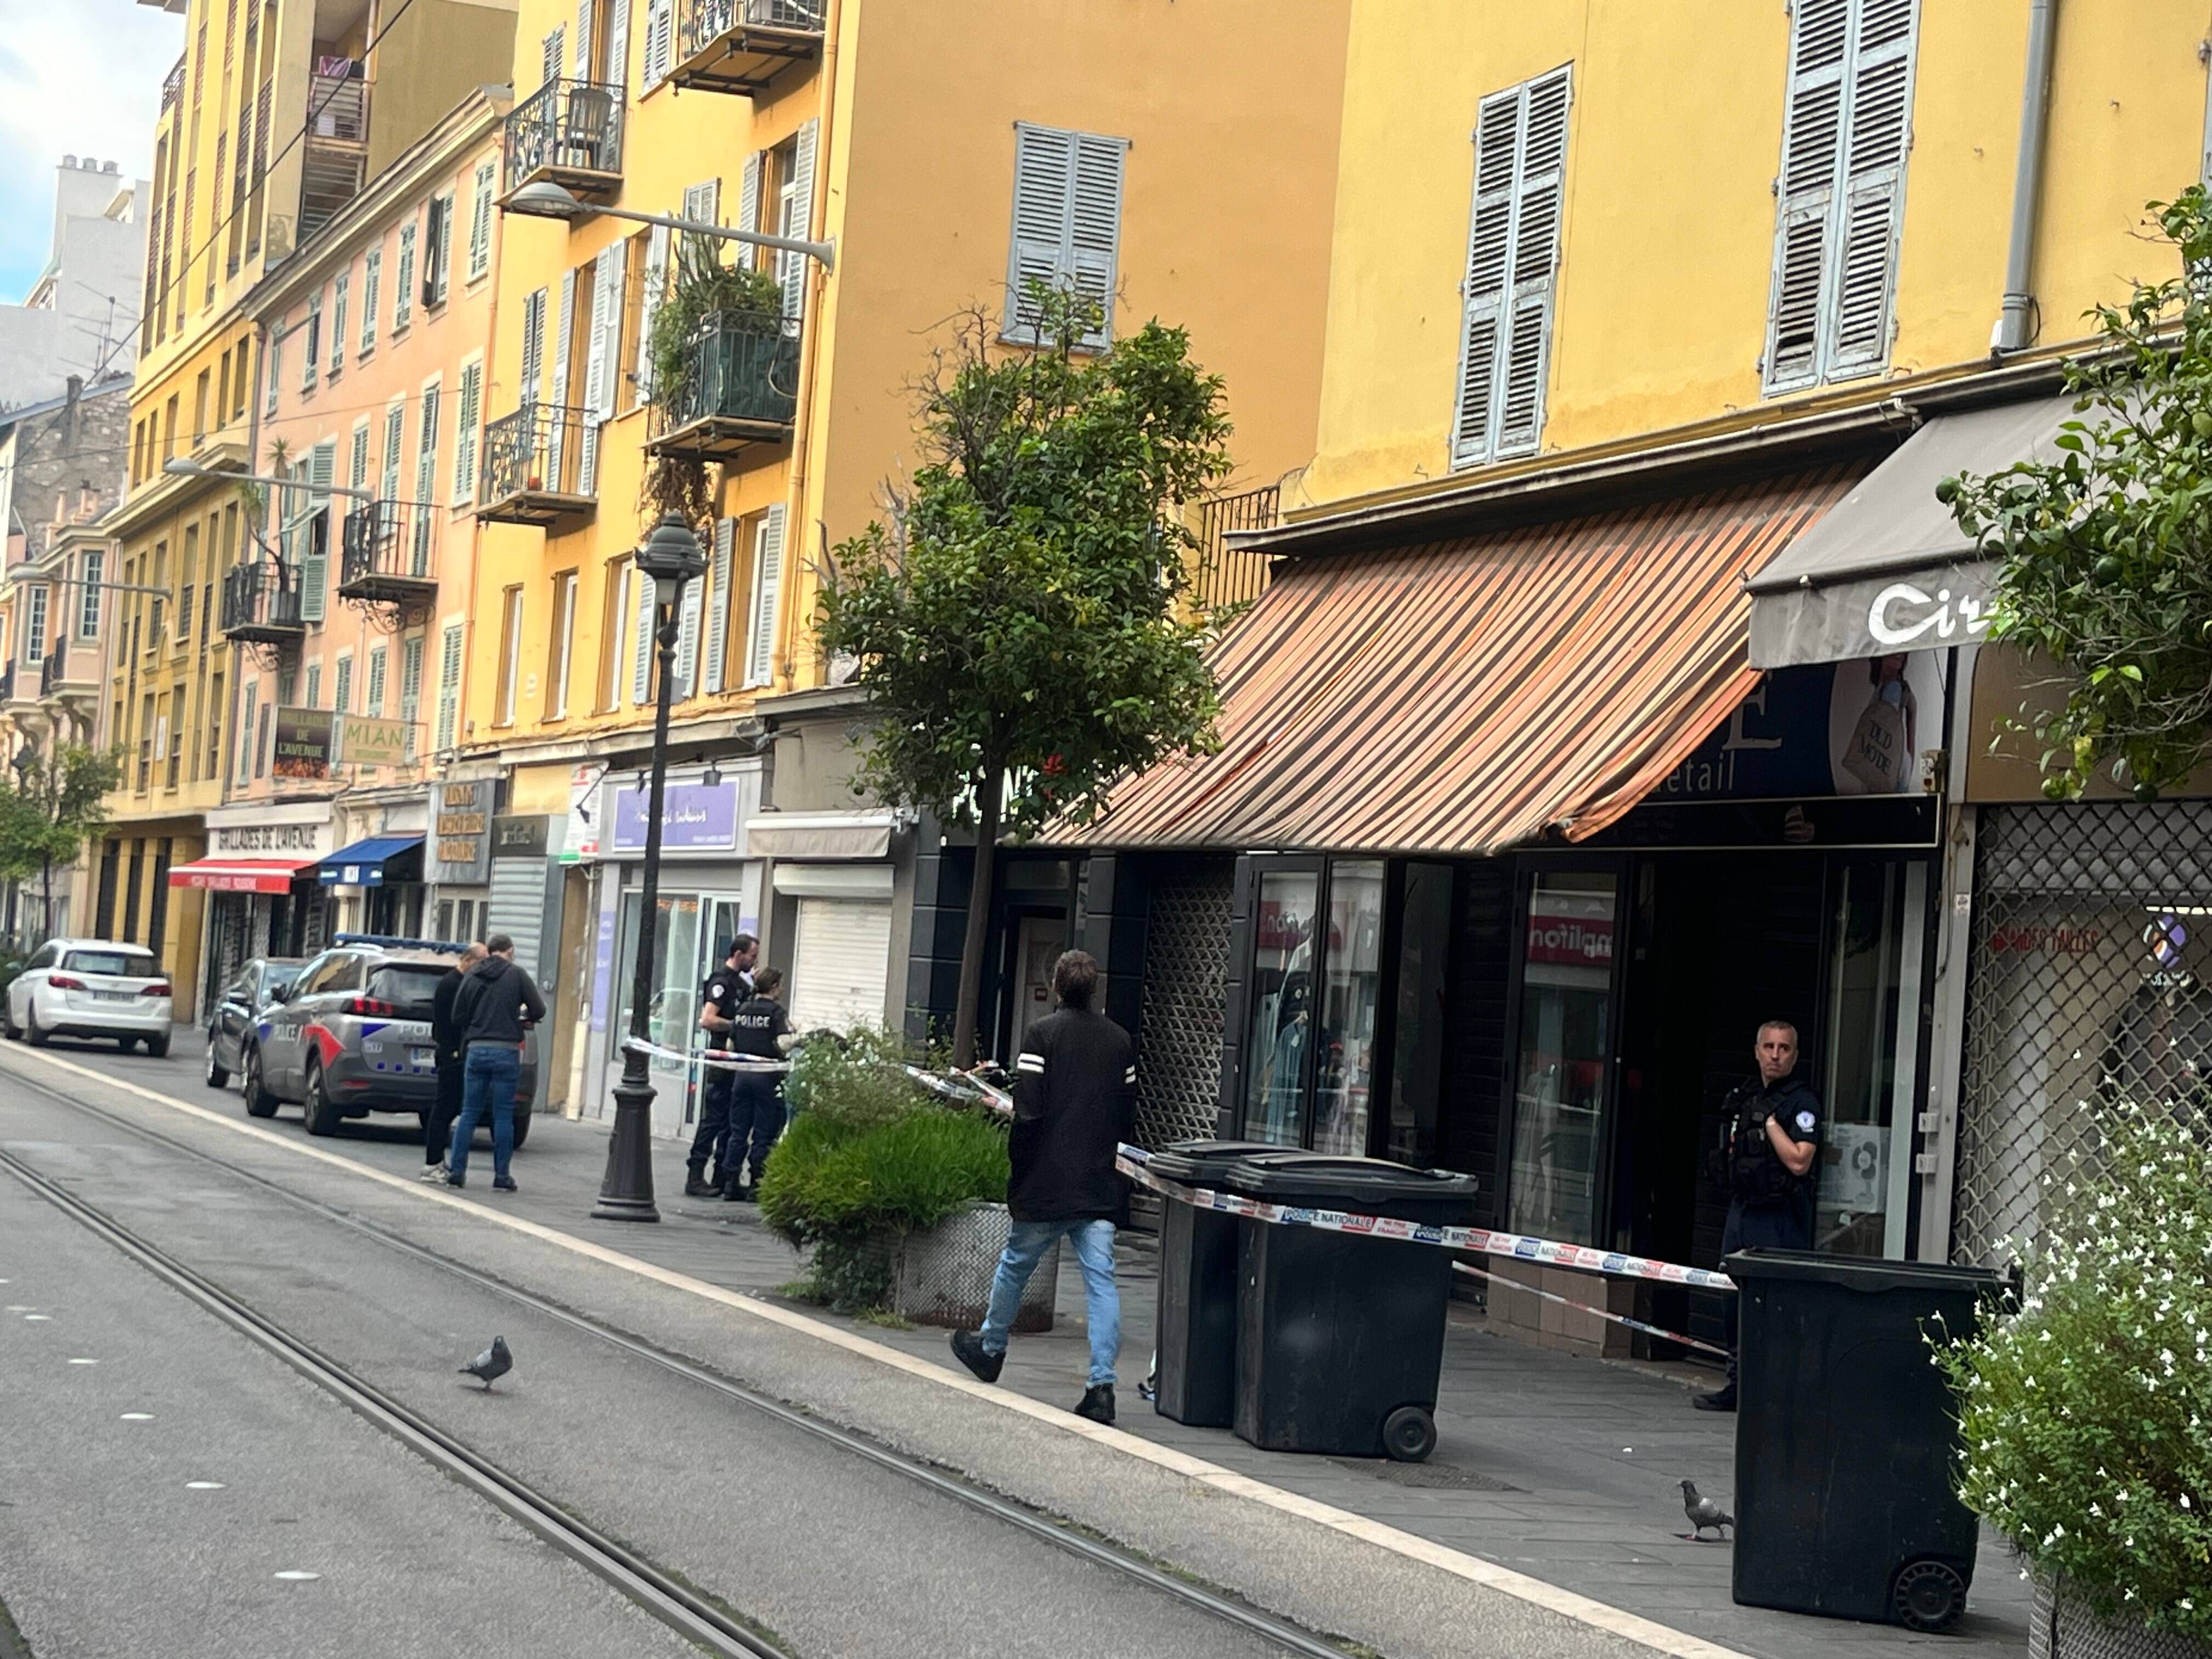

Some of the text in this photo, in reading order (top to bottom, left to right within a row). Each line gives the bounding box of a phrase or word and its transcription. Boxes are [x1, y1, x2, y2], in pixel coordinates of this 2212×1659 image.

[1868, 583, 2001, 645] Cir
[296, 728, 309, 742] DE
[346, 724, 404, 747] MIAN
[278, 742, 325, 758] L'AVENUE
[1857, 734, 1892, 777] MODE
[1650, 750, 1735, 793] etail
[262, 826, 273, 850] DE
[735, 1014, 771, 1028] POLICE
[274, 1024, 297, 1041] POLICE
[1285, 1207, 1319, 1222] POLICE
[1321, 1212, 1372, 1228] NATIONALE
